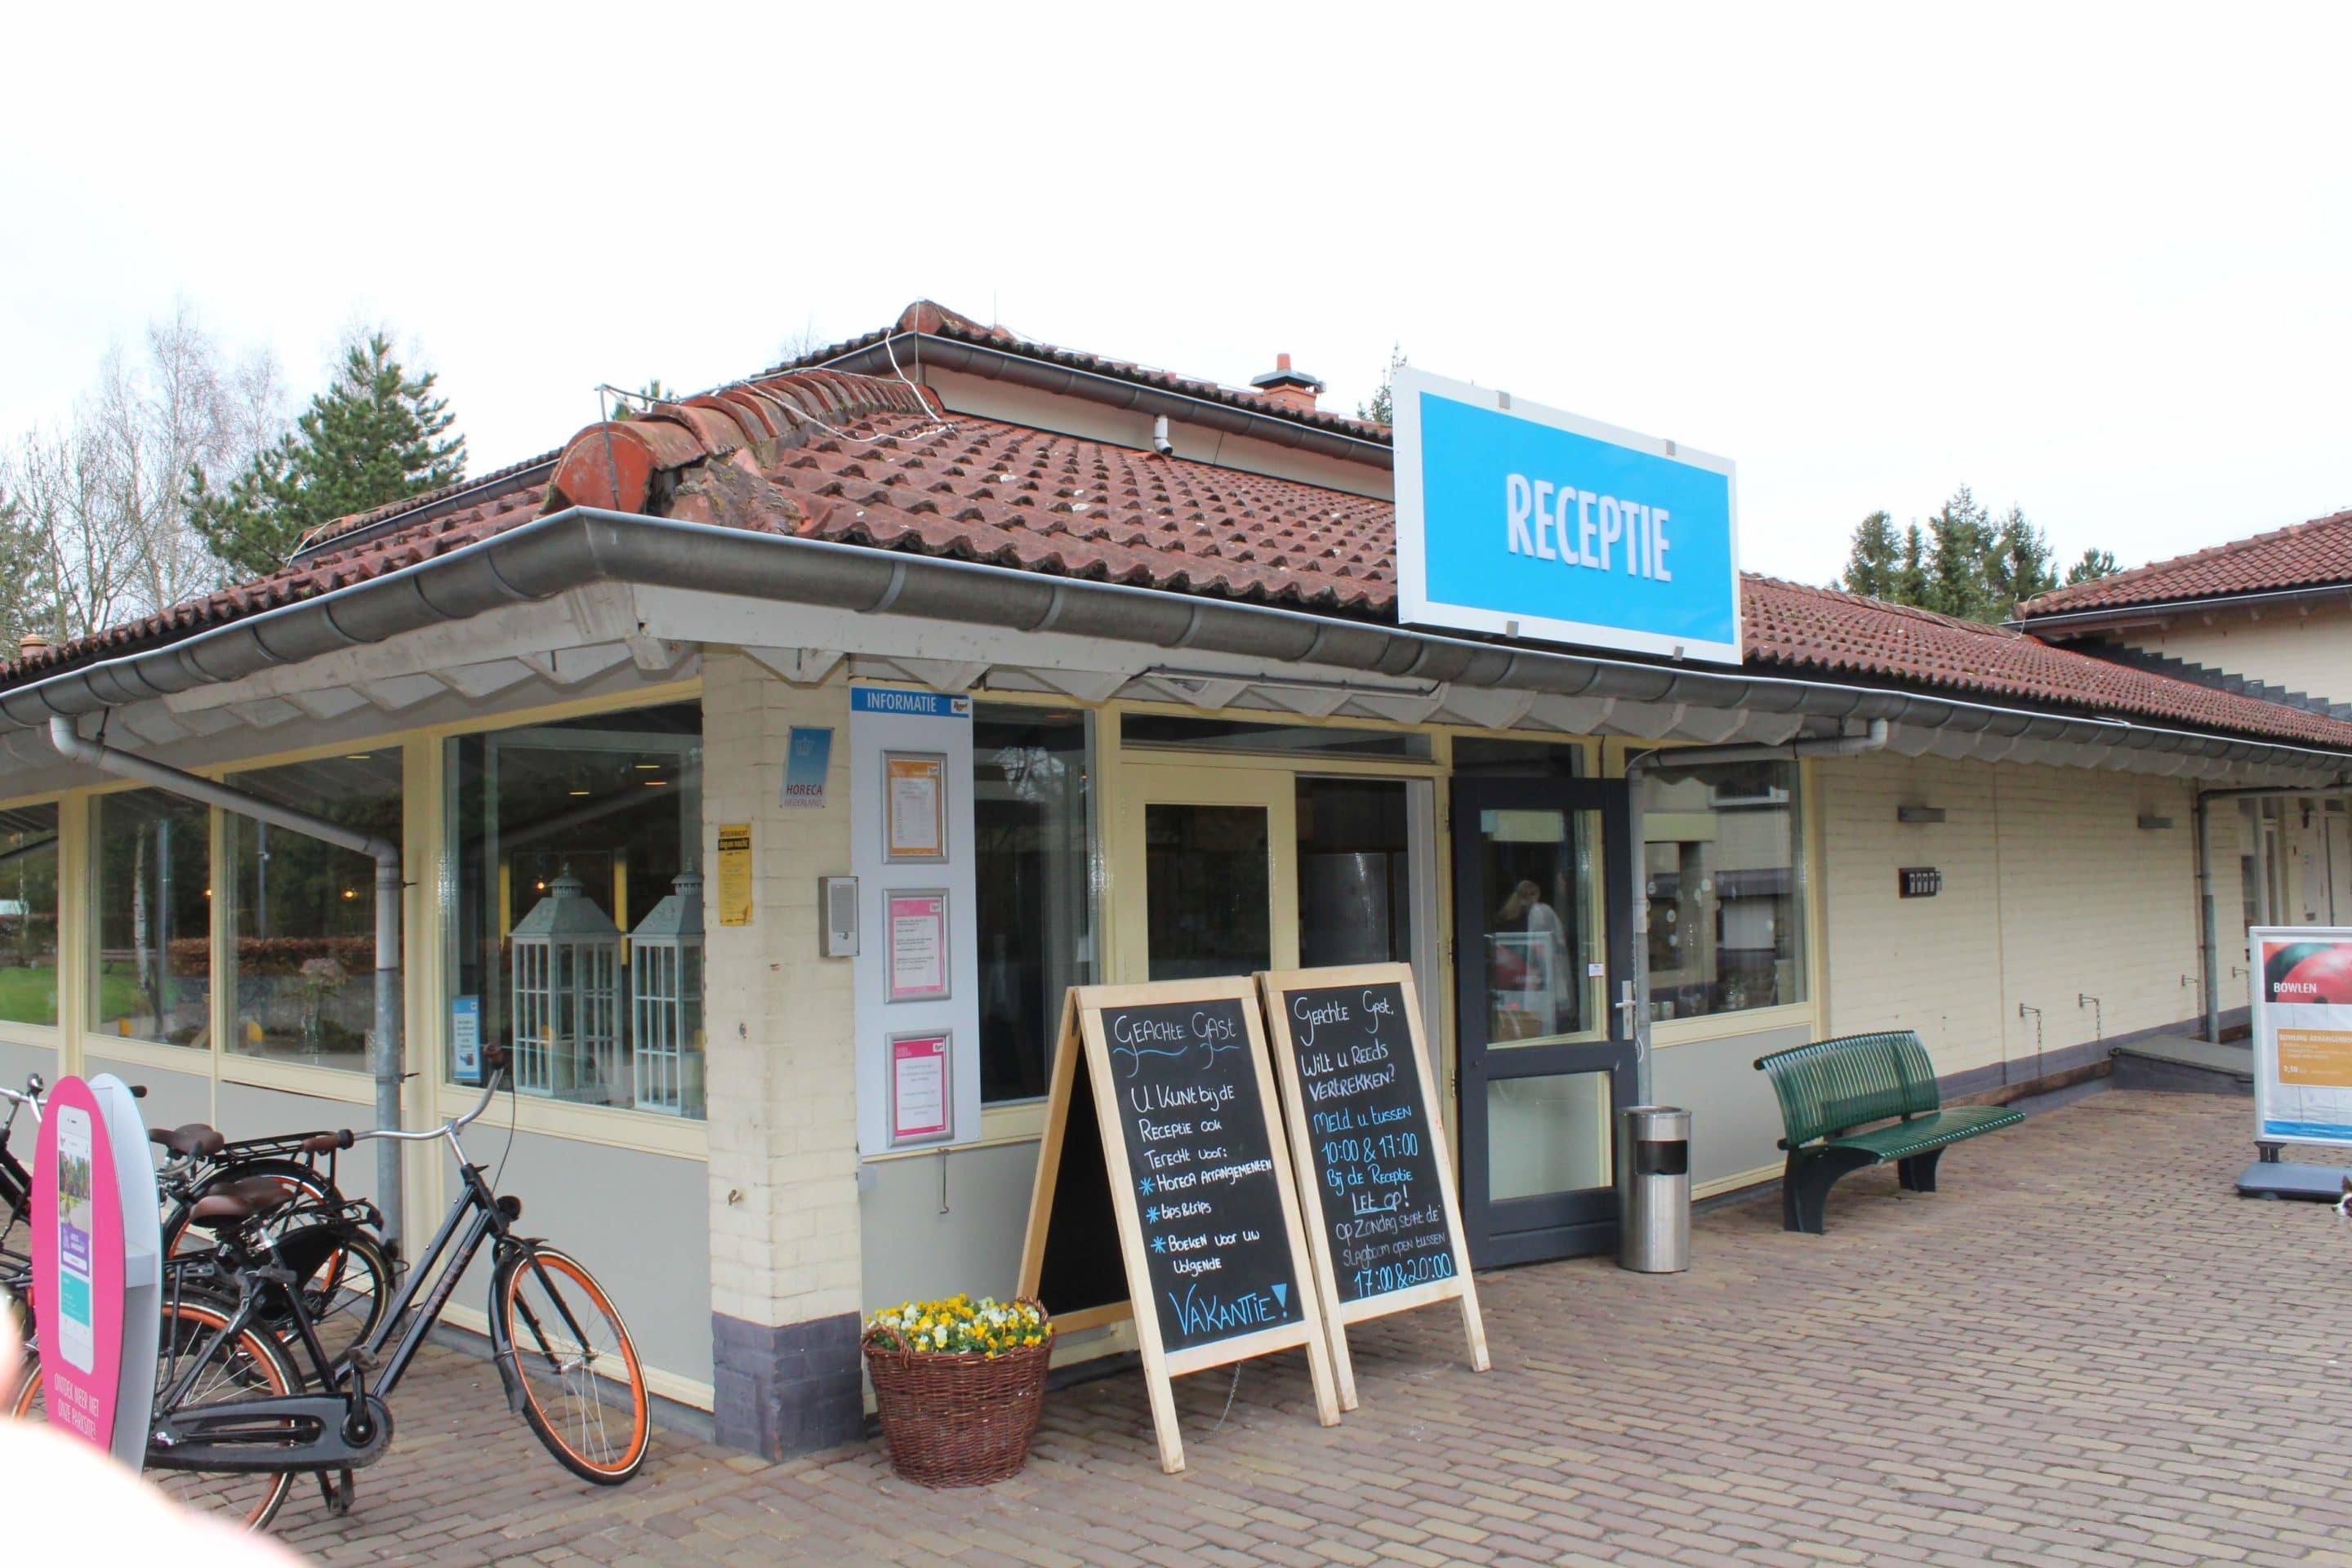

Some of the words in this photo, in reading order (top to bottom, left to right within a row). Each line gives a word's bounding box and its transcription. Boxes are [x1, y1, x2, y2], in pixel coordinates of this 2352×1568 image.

[1506, 473, 1673, 582] RECEPTIE
[867, 692, 937, 713] INFORMATIE
[786, 784, 822, 795] HORECA
[2274, 982, 2317, 994] BOWLEN
[1321, 1138, 1359, 1165] 10:00
[1363, 1137, 1376, 1163] &
[1379, 1133, 1419, 1158] 17:00
